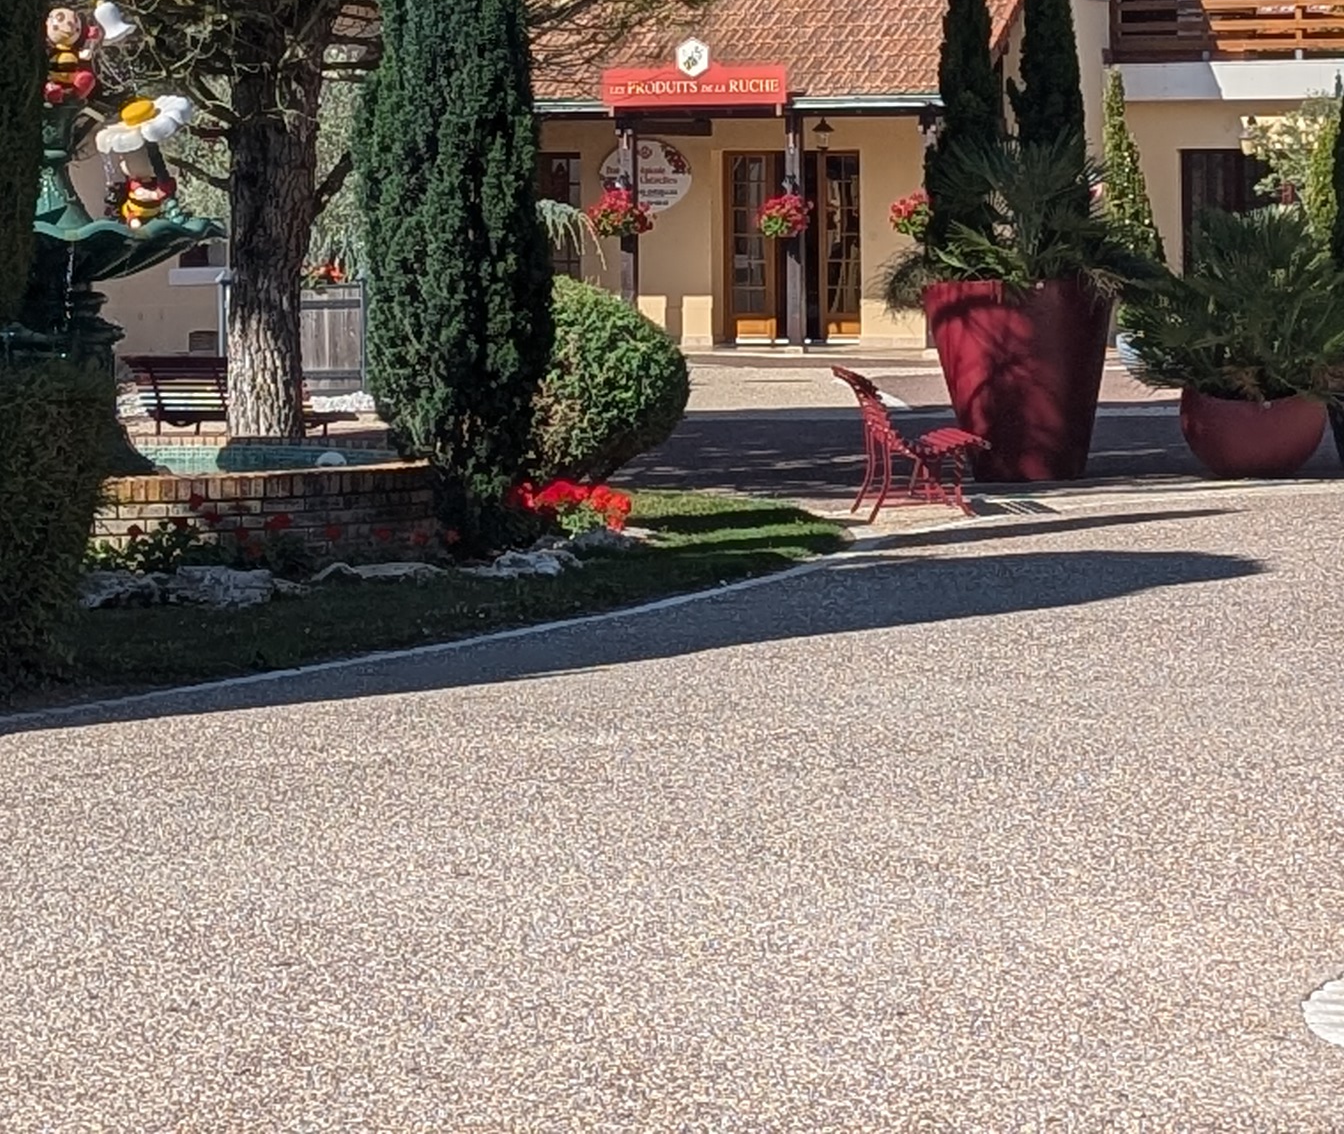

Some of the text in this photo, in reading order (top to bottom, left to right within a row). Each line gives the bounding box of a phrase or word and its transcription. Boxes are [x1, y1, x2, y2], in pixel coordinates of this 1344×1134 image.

[609, 79, 779, 95] LES PRODUITS DE LA RUCHE
